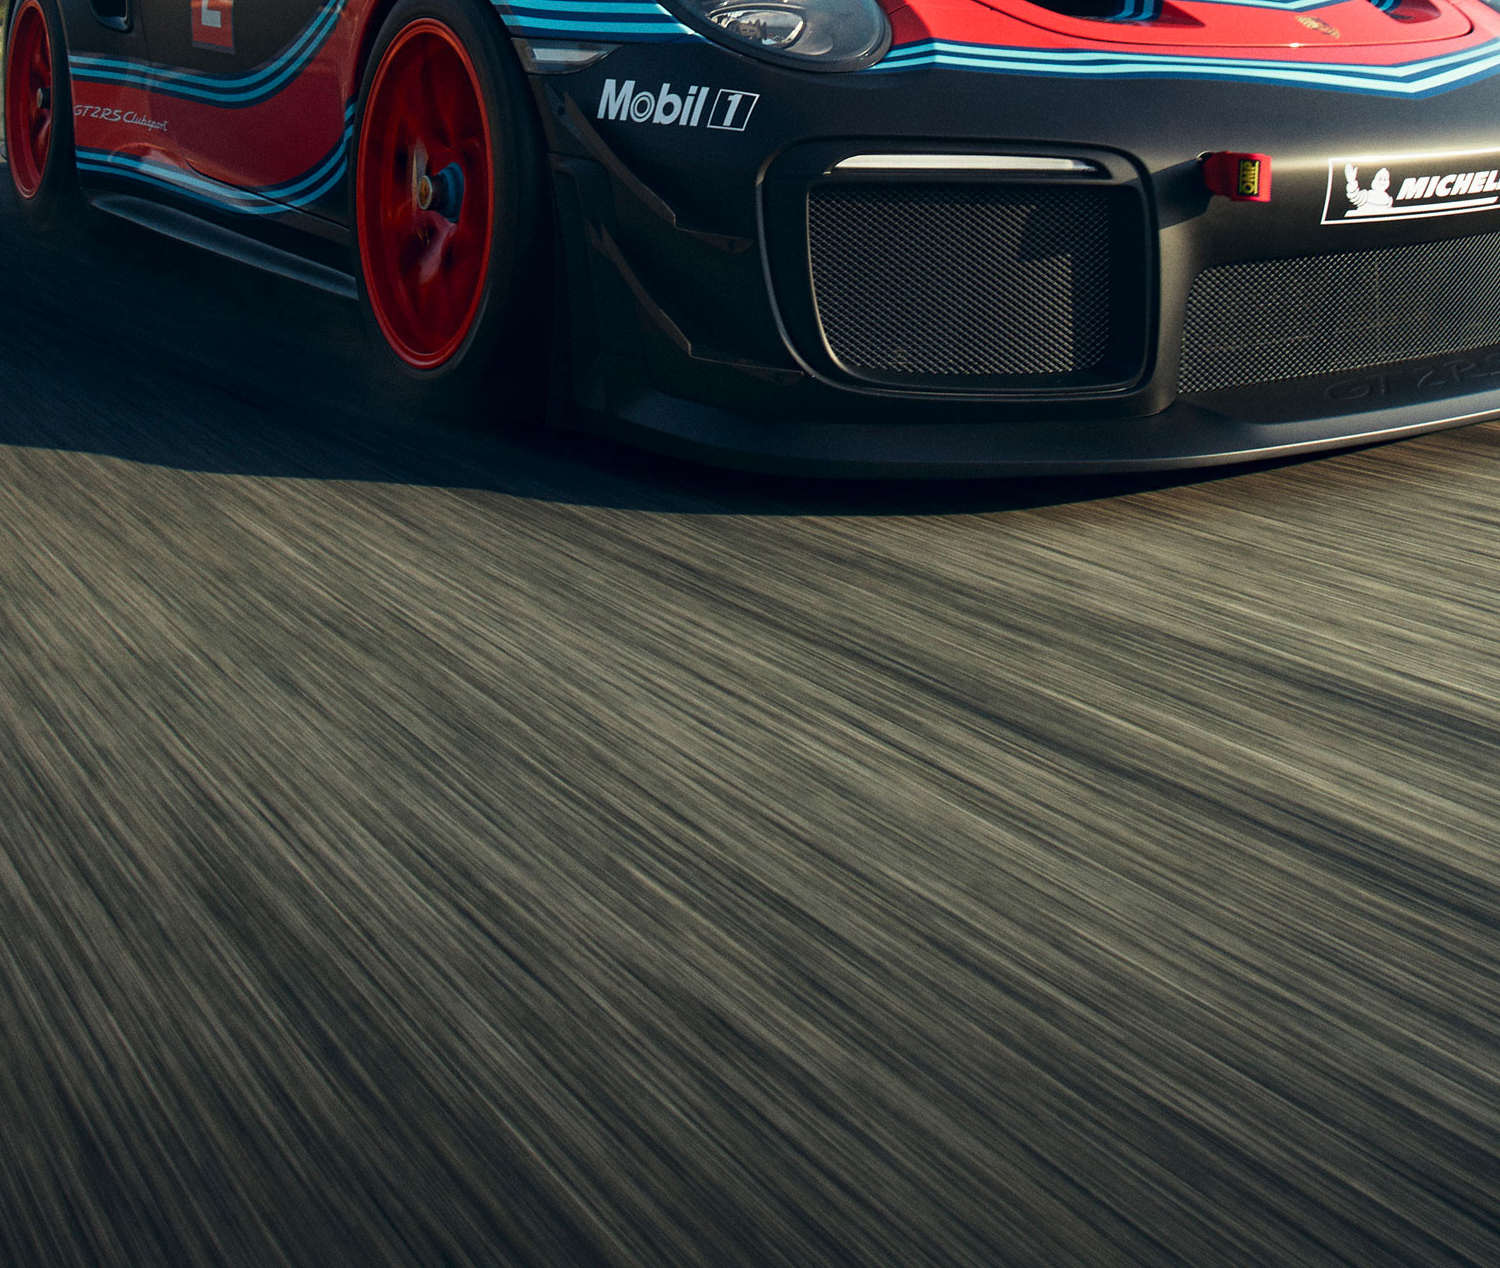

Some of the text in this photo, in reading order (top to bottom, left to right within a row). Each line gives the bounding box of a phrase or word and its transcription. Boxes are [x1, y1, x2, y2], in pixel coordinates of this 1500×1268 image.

[597, 78, 743, 127] Mobil 1
[123, 111, 168, 132] Clubsport
